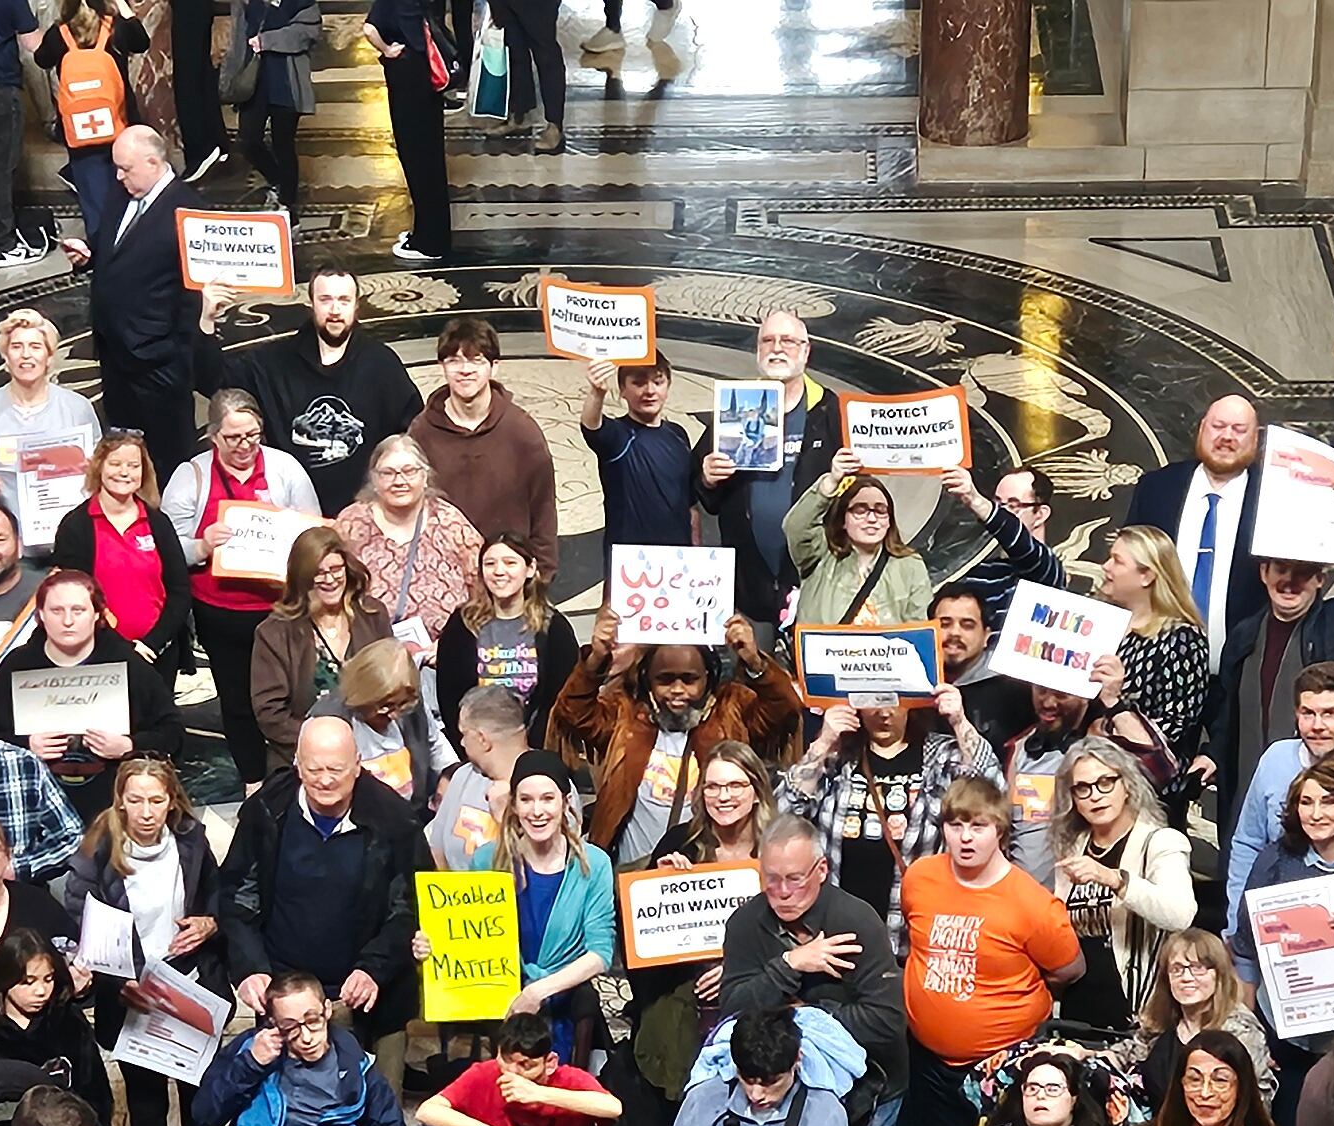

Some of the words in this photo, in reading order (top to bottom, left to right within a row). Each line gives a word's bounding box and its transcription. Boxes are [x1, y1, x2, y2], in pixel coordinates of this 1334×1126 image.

[205, 225, 253, 236] PROTECT
[225, 244, 275, 254] WAIVERS
[567, 295, 617, 310] PROTECT
[586, 315, 640, 327] WAIVERS
[871, 406, 928, 419] PROTECT
[852, 424, 892, 437] AD/TBI
[895, 420, 954, 435] WAIVERS
[621, 565, 683, 589] We
[623, 593, 669, 618] go
[1031, 603, 1059, 628] My
[826, 648, 867, 656] Protect
[869, 645, 907, 658] AD/TBI
[841, 663, 892, 672] WAIVERS
[661, 878, 725, 895] PROTECT
[427, 884, 506, 909] Disabled
[637, 902, 685, 919] AD/TBI
[448, 916, 505, 940] LIVES
[929, 927, 979, 951] RIGHTS
[432, 954, 516, 980] MATTER
